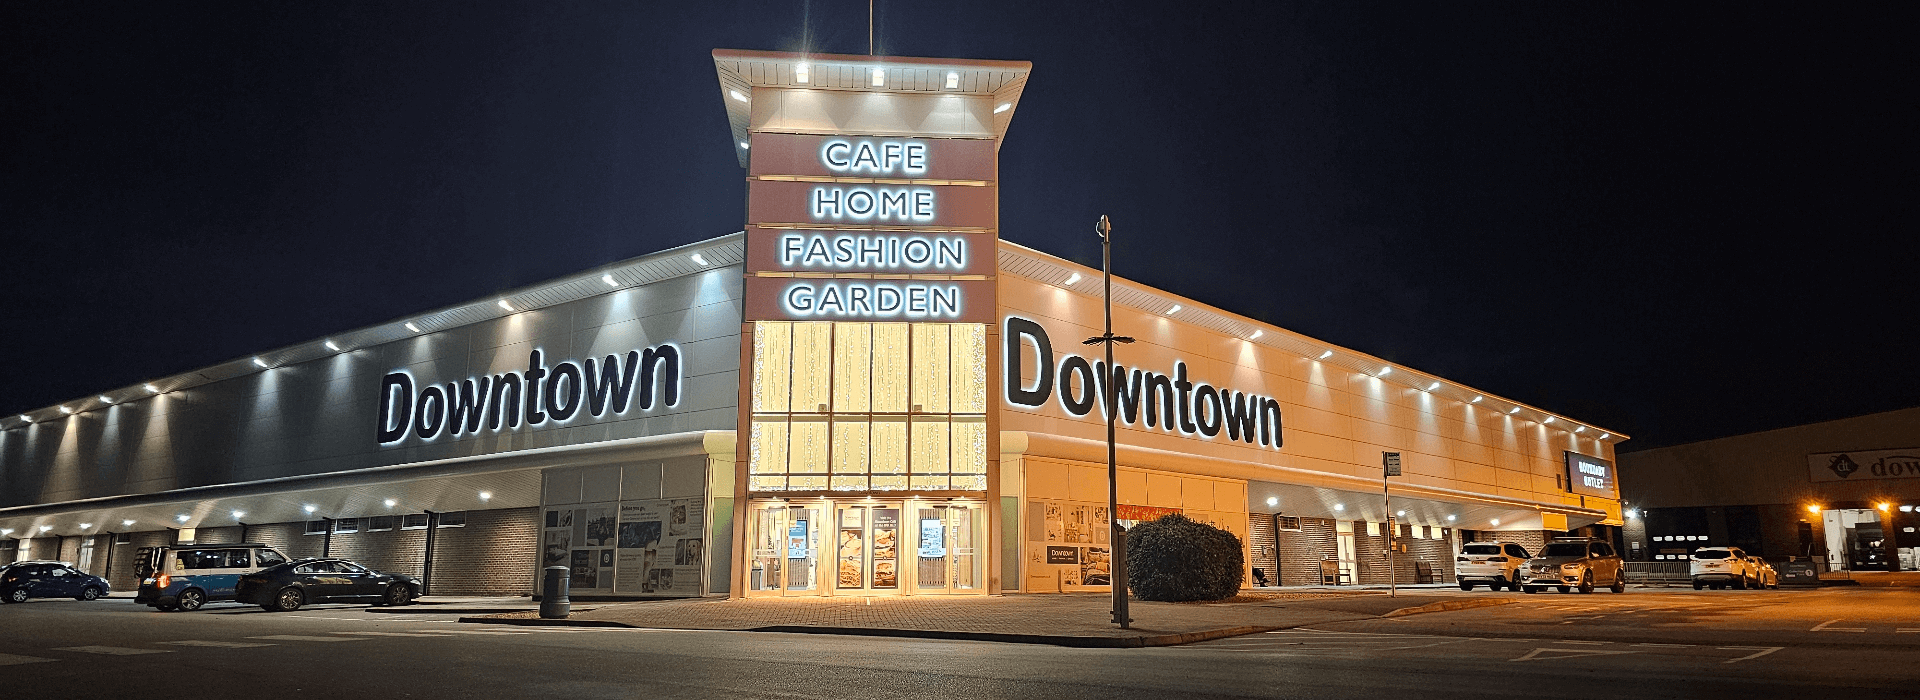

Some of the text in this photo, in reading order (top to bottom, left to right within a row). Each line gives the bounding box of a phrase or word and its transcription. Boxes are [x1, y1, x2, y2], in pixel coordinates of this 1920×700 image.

[825, 142, 924, 170] CAFE
[816, 190, 931, 217] HOME
[784, 237, 963, 265] FASHION
[787, 286, 957, 314] GARDEN
[377, 343, 680, 445] Downtown
[1006, 316, 1284, 449] Downtown
